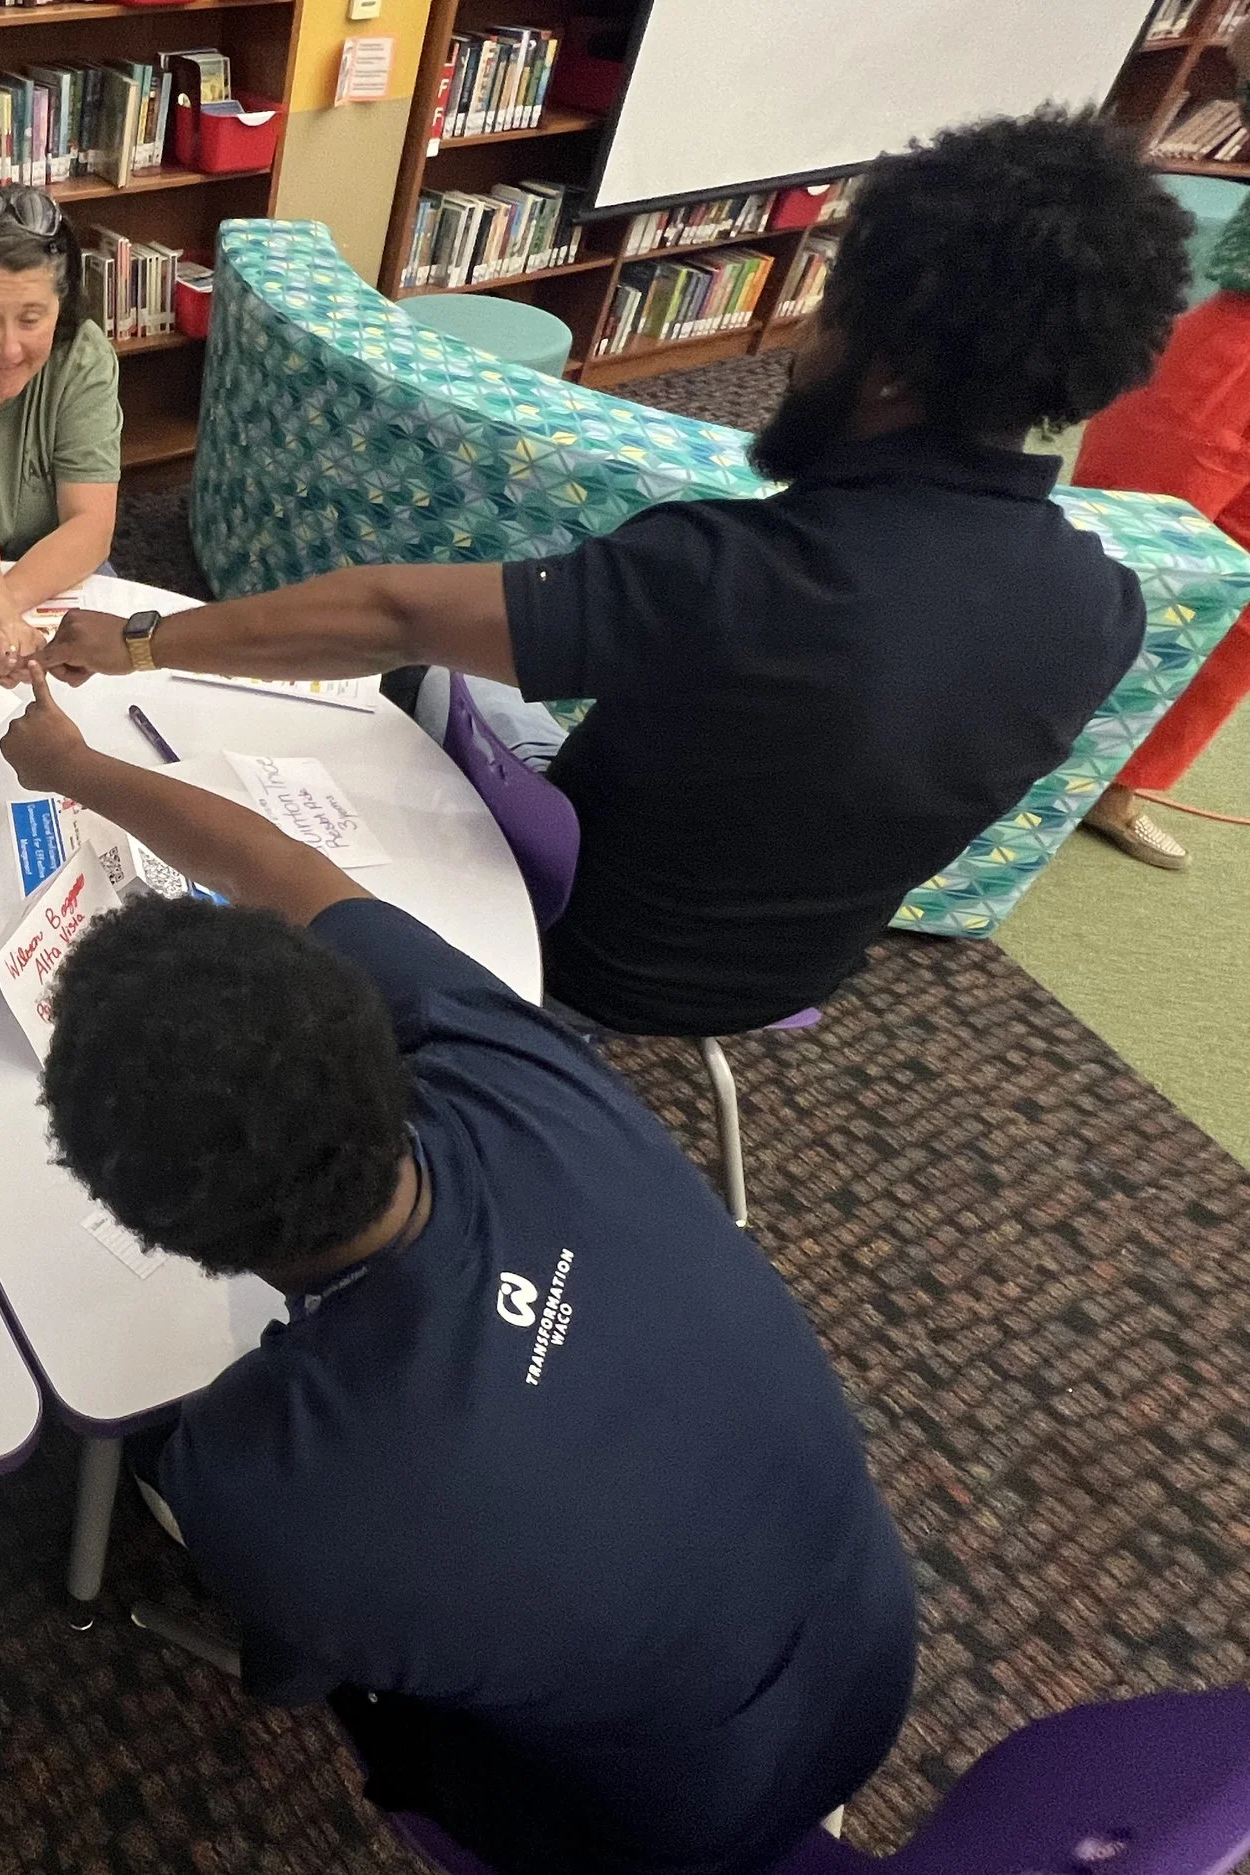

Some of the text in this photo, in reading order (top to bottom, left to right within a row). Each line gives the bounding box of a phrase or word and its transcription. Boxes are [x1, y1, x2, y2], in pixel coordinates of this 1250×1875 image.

[437, 79, 449, 98] F
[432, 107, 443, 126] F
[34, 912, 86, 984] Alta Vista
[525, 1248, 575, 1386] TRANSFORMATION
[550, 1302, 573, 1346] WACO
